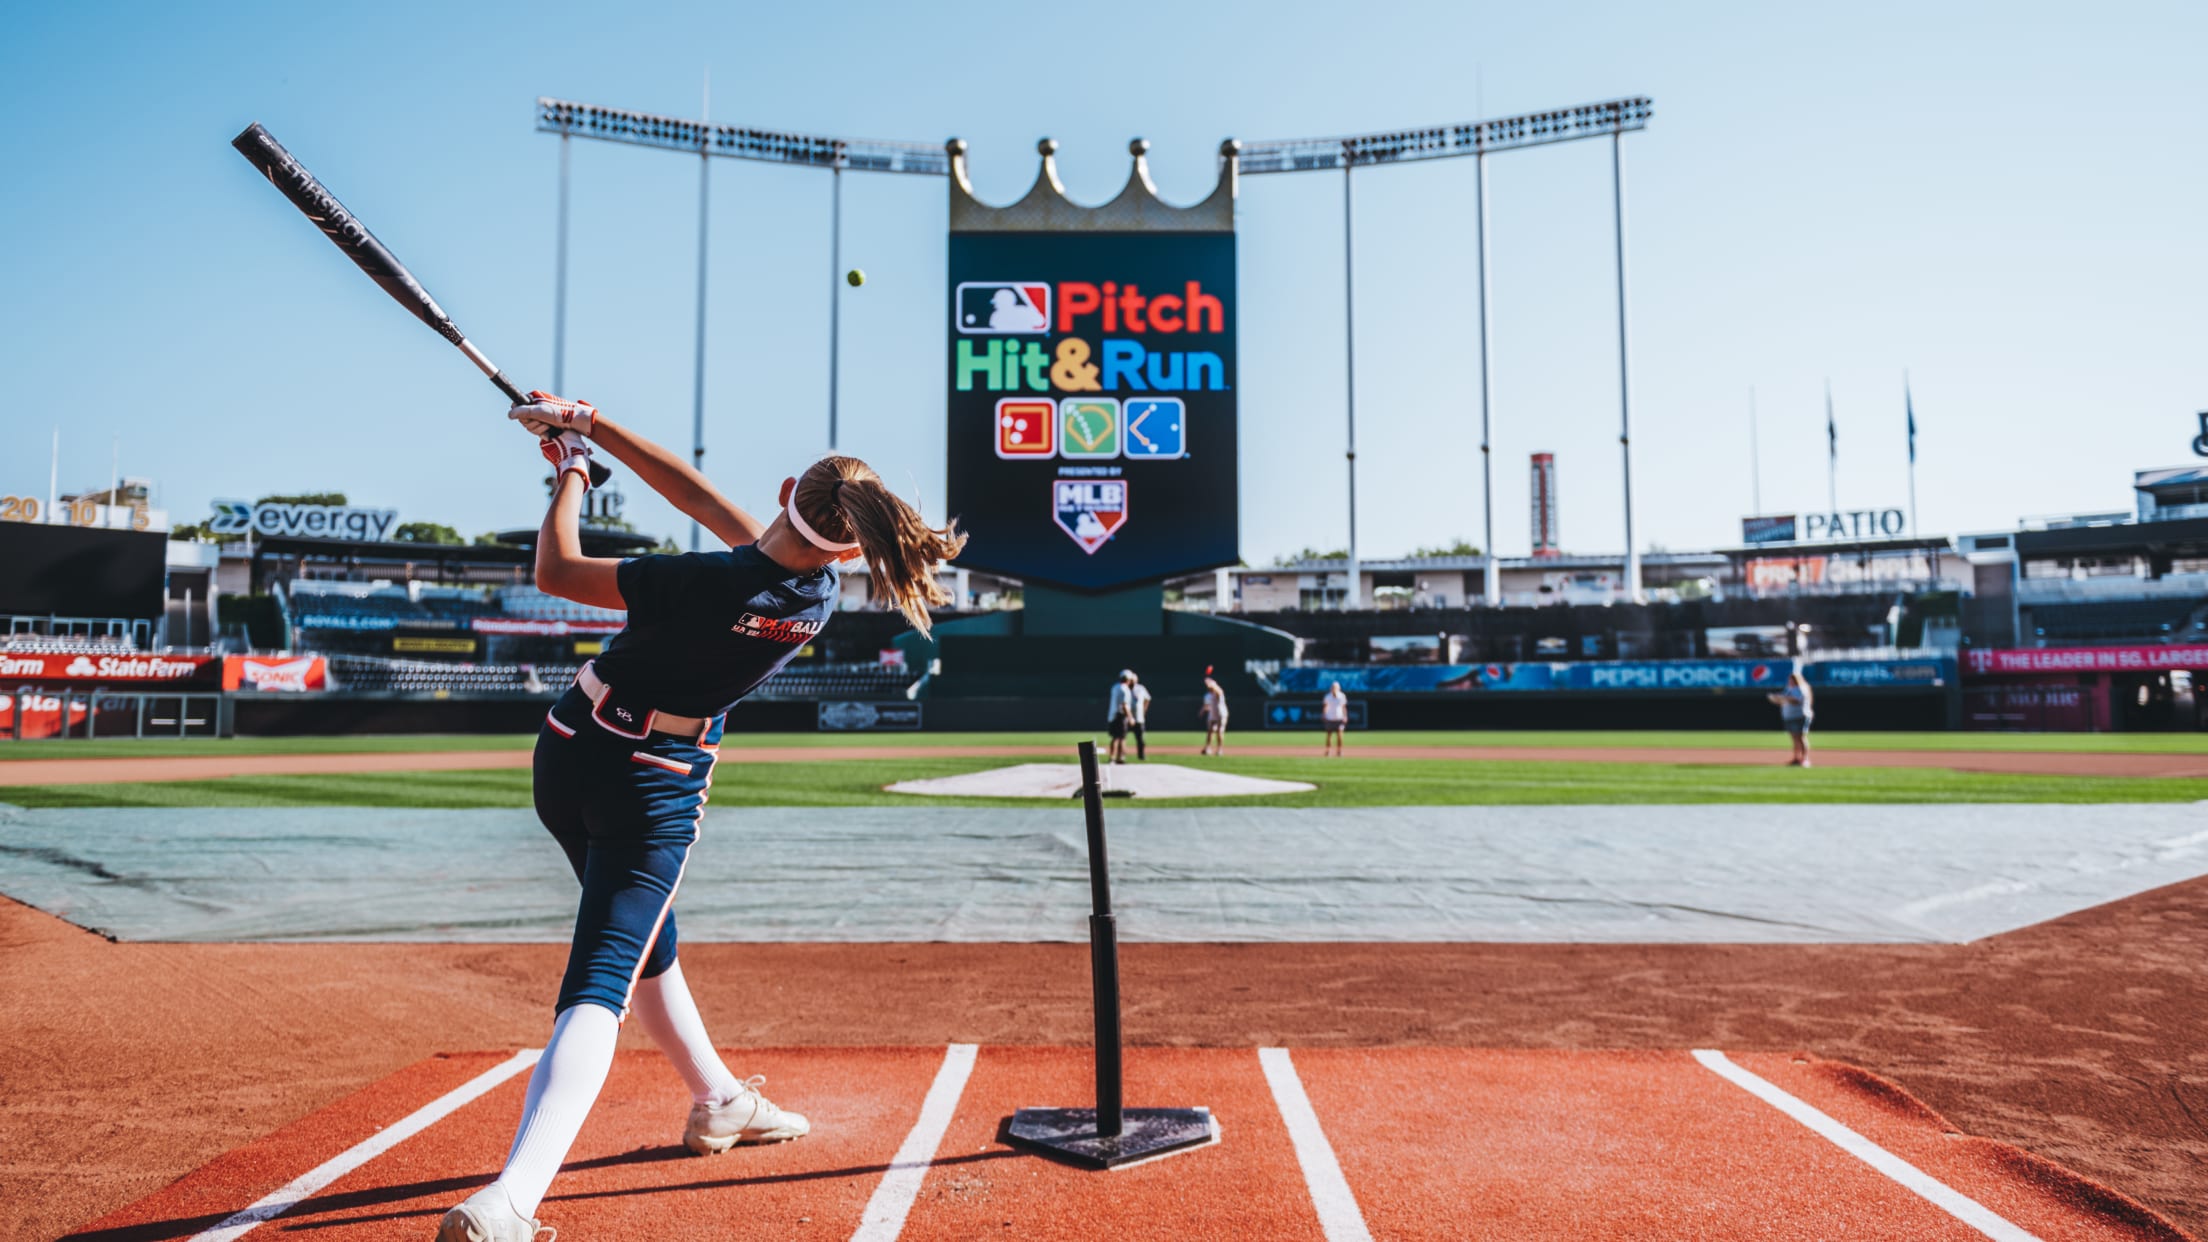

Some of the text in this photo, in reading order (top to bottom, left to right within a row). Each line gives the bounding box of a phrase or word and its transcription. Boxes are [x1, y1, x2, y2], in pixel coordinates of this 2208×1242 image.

[279, 154, 370, 248] LOUISVILLE
[1057, 281, 1225, 333] Pitch
[1059, 484, 1121, 505] MLB
[2, 496, 38, 522] 20
[71, 500, 97, 527] 10
[258, 508, 394, 542] evergy
[1805, 508, 1904, 539] PATIO
[2001, 653, 2030, 668] THE
[2033, 652, 2096, 668] LEADER
[2099, 650, 2116, 667] IN
[251, 671, 301, 685] SONIC
[1593, 667, 1746, 687] PEPSI PORCH
